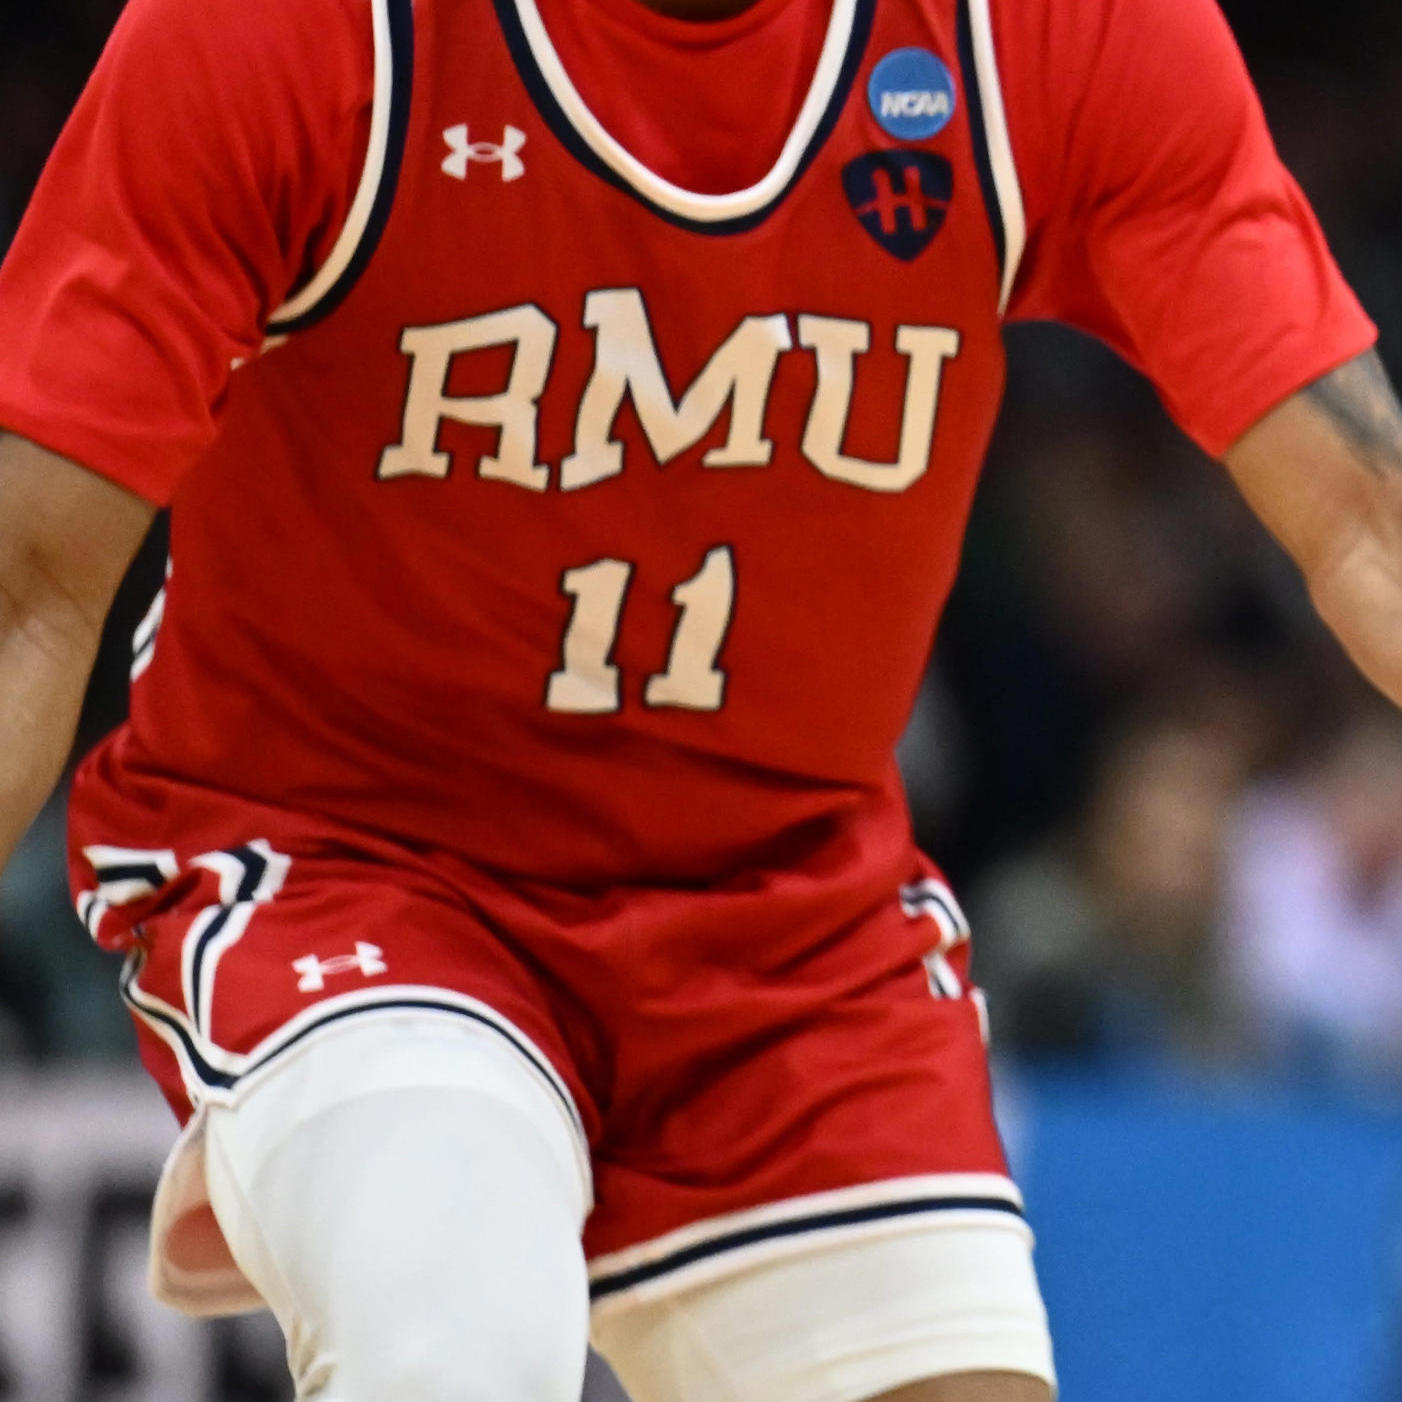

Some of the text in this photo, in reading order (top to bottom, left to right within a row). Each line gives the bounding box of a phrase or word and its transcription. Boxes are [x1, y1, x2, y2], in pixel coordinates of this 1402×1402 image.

[880, 89, 949, 119] NCAA
[376, 287, 960, 493] RMU
[545, 544, 734, 715] 11
